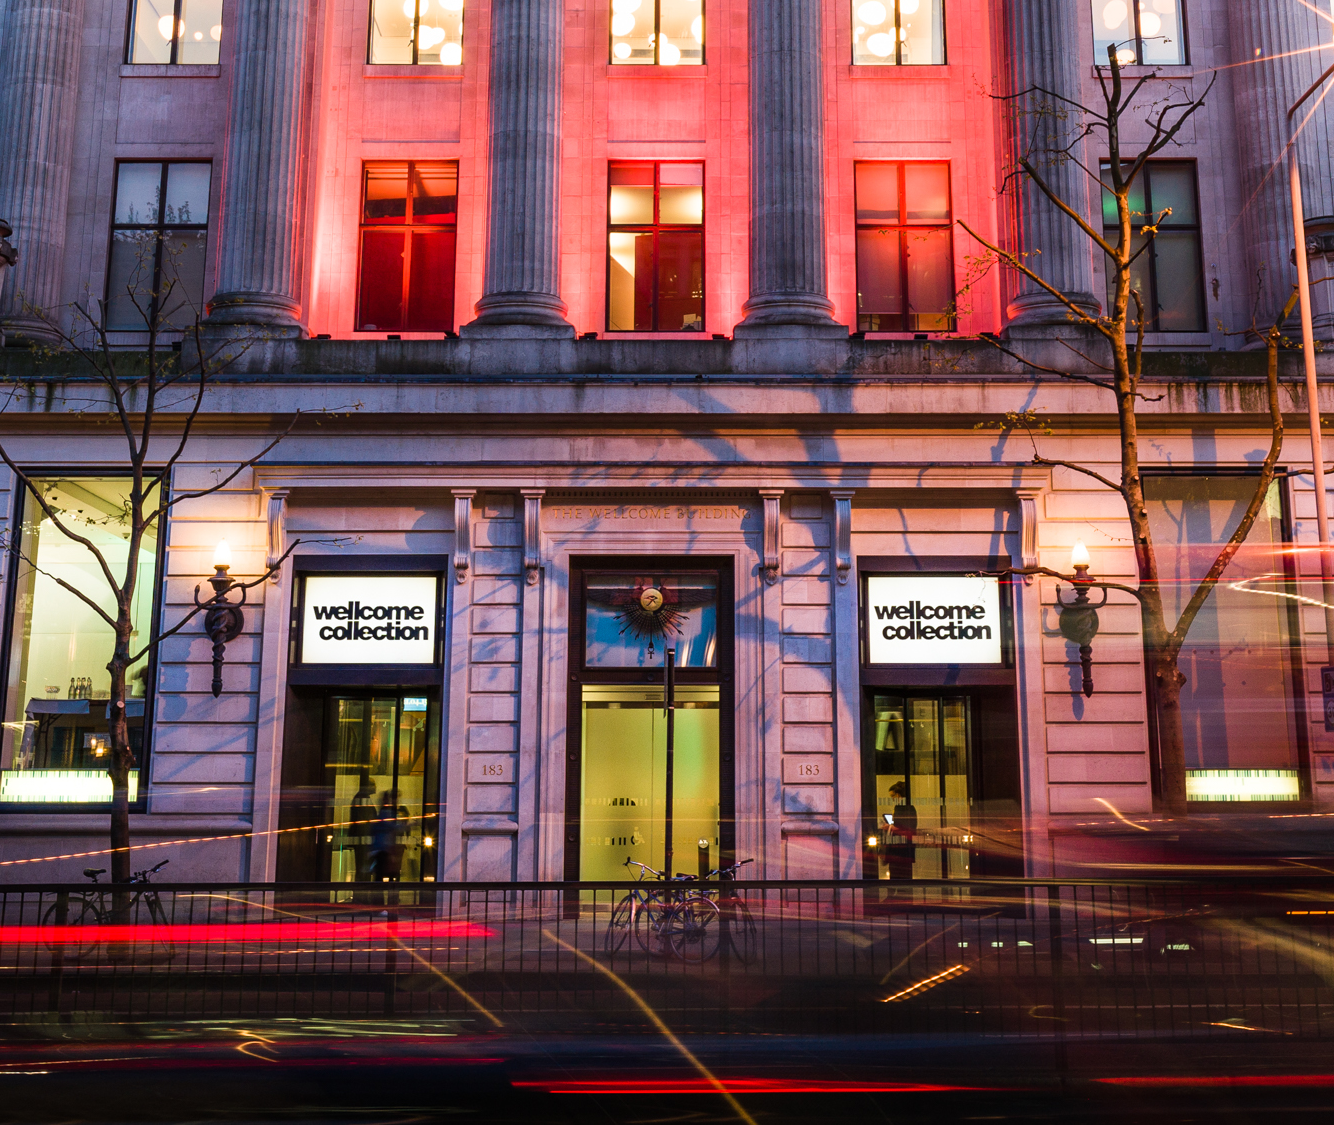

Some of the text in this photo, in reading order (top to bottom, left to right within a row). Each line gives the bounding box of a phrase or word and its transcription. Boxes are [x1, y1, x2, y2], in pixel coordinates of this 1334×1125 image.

[552, 508, 752, 520] THE WELLCOME BUILDING
[313, 601, 424, 620] wellcome
[874, 601, 985, 620] wellcome
[319, 621, 429, 640] collection
[882, 621, 992, 640] collection
[482, 764, 504, 776] 183
[798, 764, 820, 776] 183
